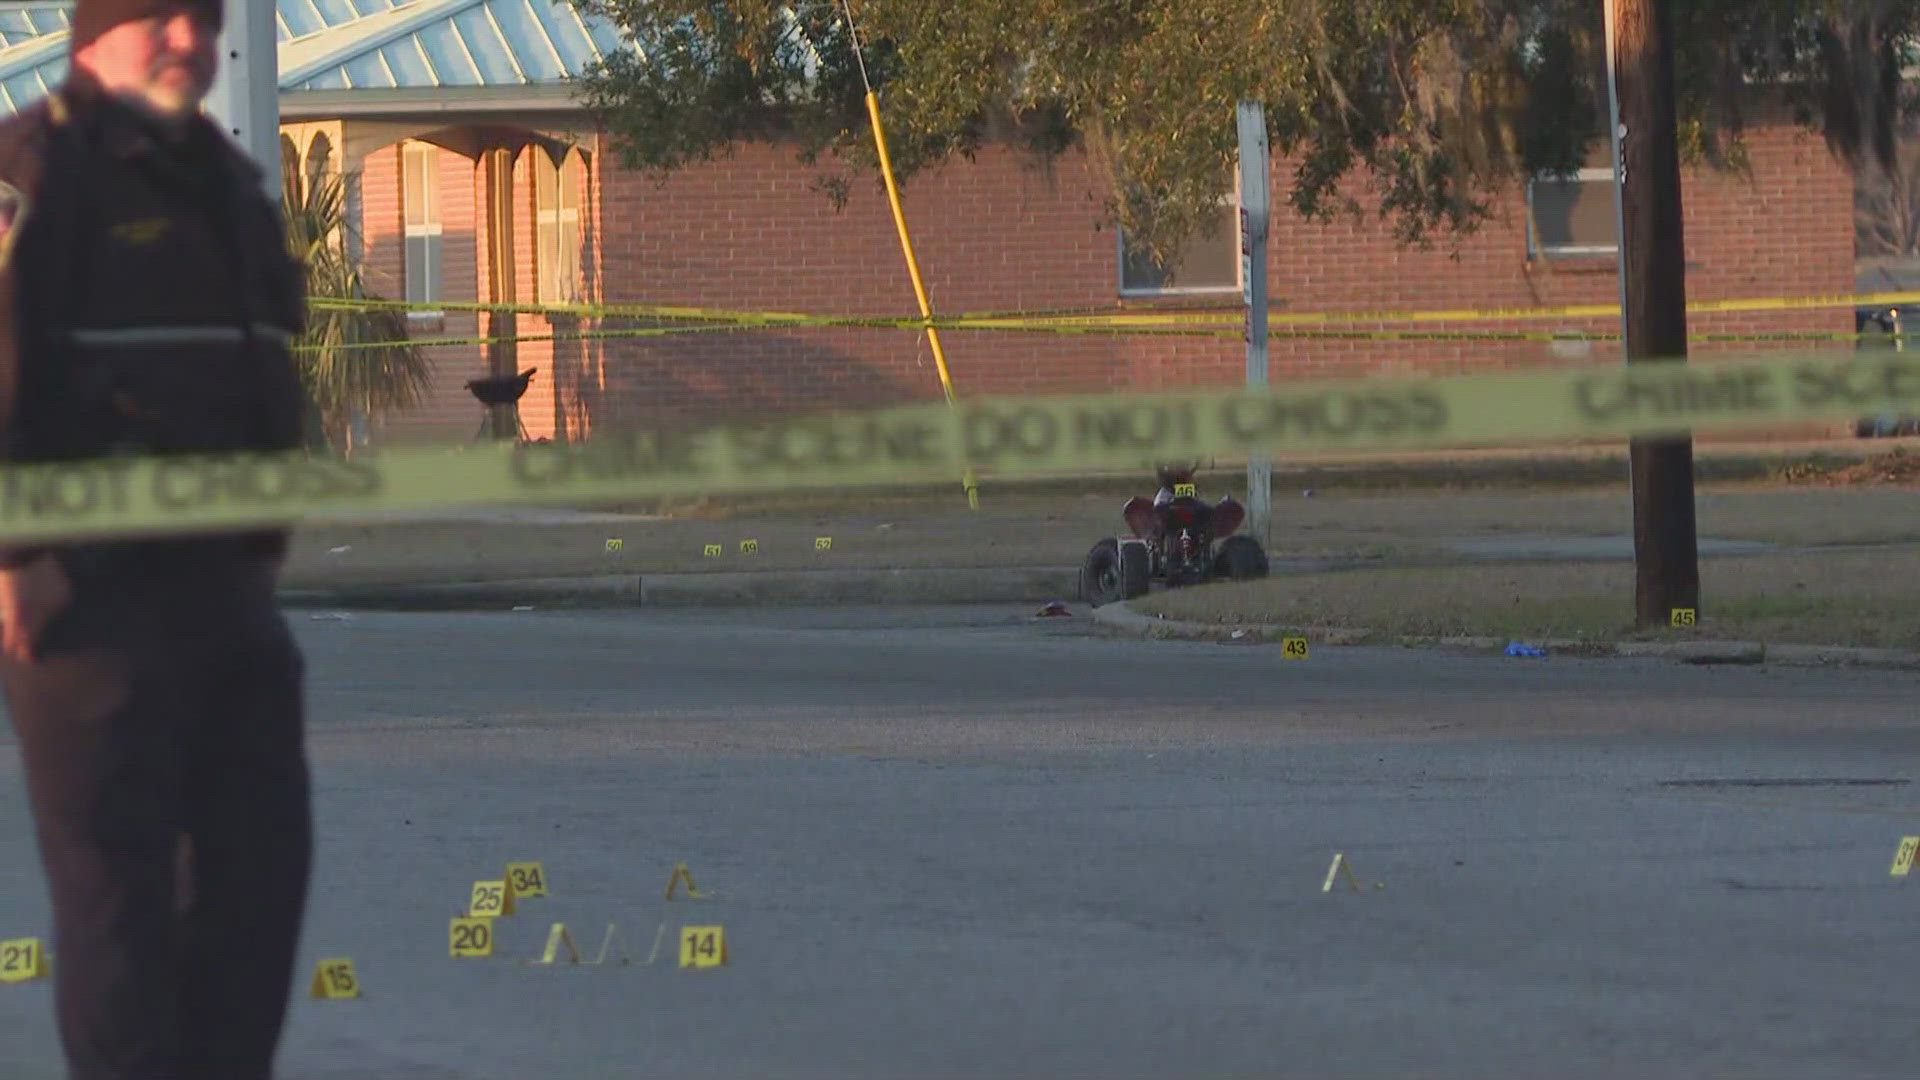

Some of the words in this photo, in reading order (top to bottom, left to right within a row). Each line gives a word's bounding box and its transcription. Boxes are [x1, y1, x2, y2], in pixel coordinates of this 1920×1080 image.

[1674, 611, 1693, 625] 45
[1287, 640, 1306, 655] 43
[513, 868, 541, 891] 34
[473, 886, 499, 911] 25
[453, 925, 488, 949] 20
[687, 933, 715, 958] 14
[4, 943, 31, 971] 21
[328, 964, 353, 991] 15
